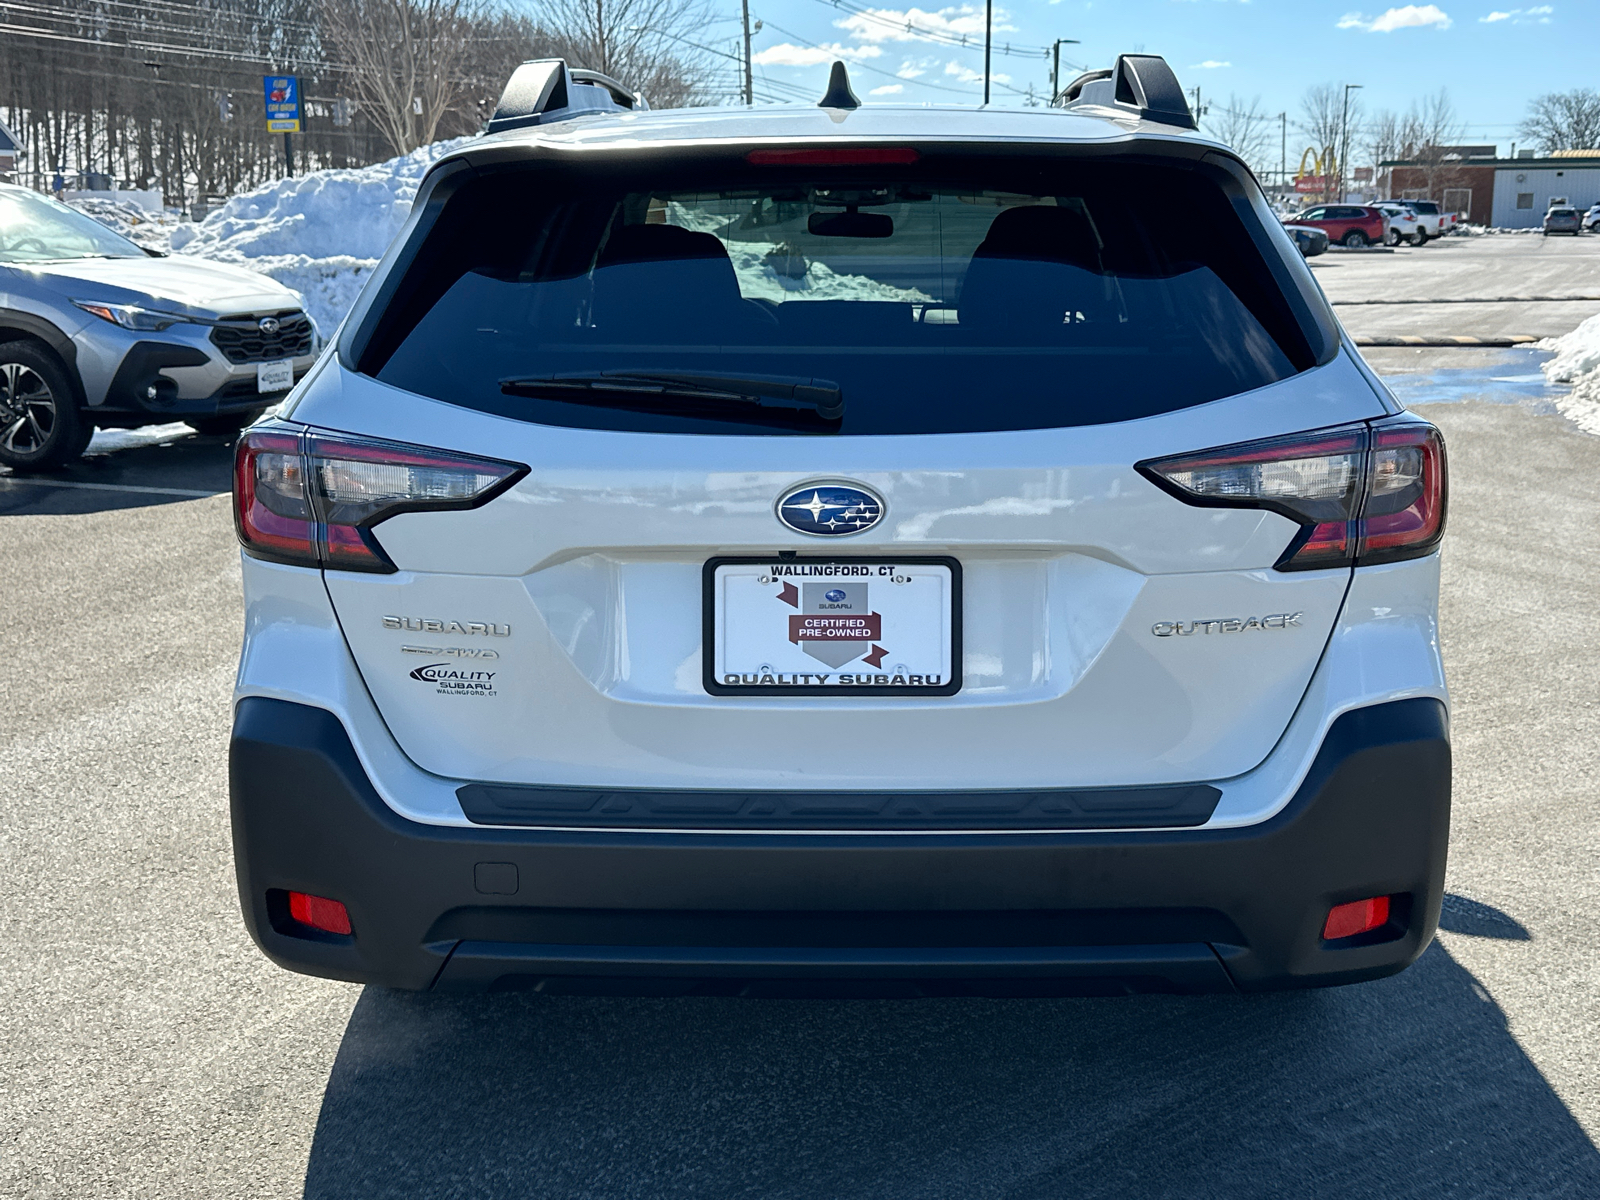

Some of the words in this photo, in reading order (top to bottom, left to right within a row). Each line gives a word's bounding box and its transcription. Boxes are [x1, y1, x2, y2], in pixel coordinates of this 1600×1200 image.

[771, 566, 873, 577] WALLINGFORD,
[878, 566, 896, 576] CT
[382, 615, 511, 638] SUBARU
[804, 619, 866, 628] CERTIFIED
[1151, 611, 1304, 637] OUTBACK
[798, 628, 871, 638] PRE-OWNED
[437, 647, 500, 660] AWD
[424, 669, 496, 680] QUALITY
[724, 674, 830, 686] QUALITY
[839, 674, 941, 686] SUBARU
[439, 681, 493, 690] SUBARU
[436, 688, 487, 697] WALLINGFORD,
